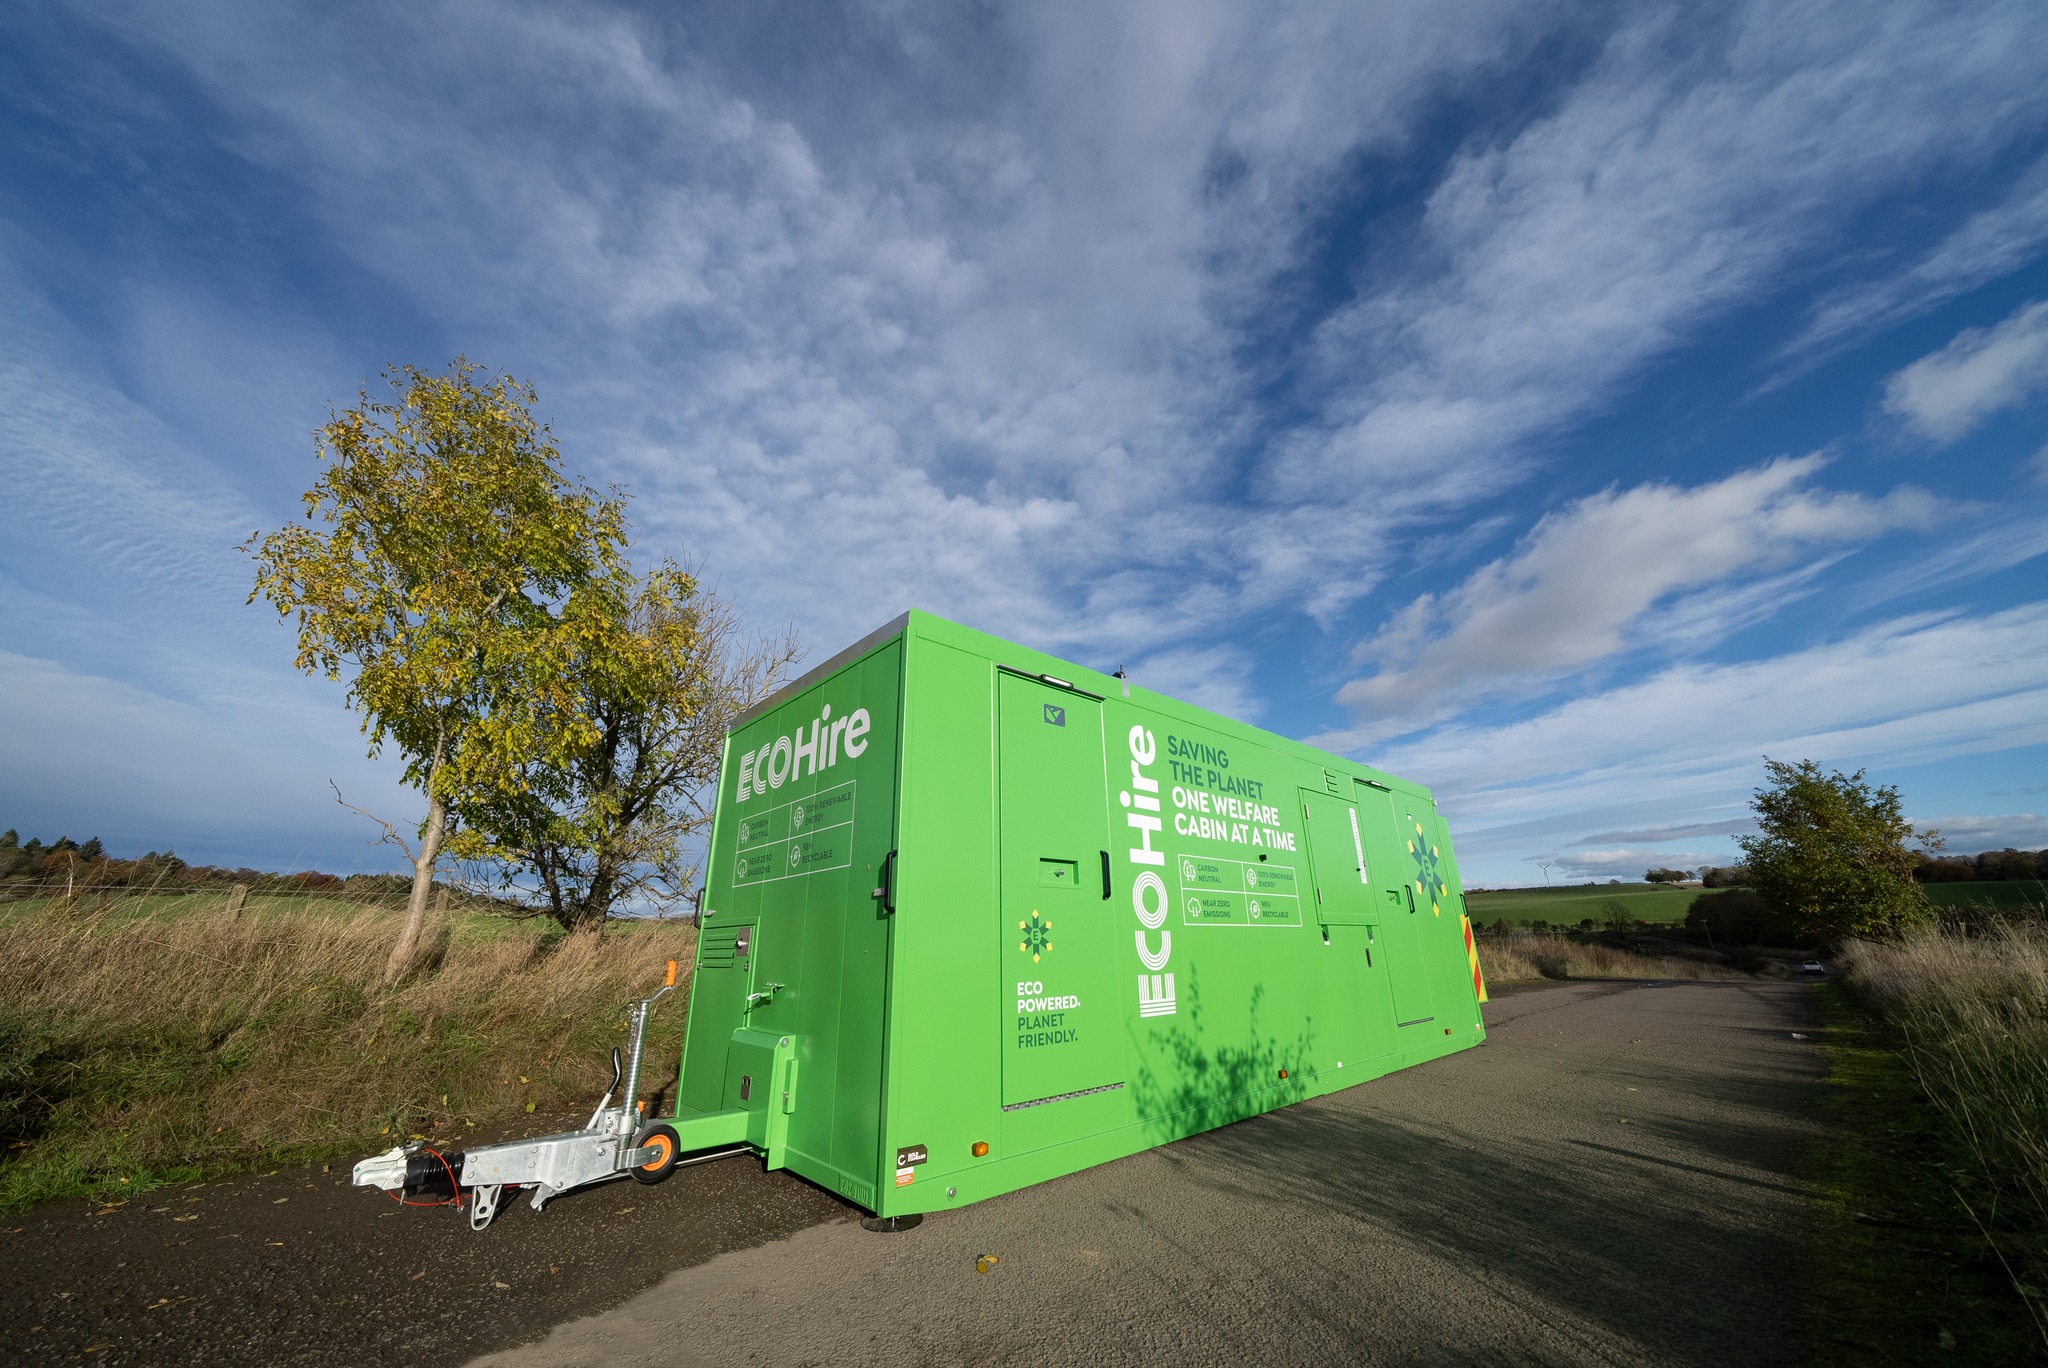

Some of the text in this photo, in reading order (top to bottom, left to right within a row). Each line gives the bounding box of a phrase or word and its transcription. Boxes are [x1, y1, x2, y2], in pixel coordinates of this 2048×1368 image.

[736, 704, 870, 803] ECOHire
[1167, 735, 1229, 769] SAVING
[1169, 760, 1263, 800] THE PLANET
[819, 791, 852, 809] RENEWABLE
[1172, 786, 1280, 826] ONE WELFARE
[751, 820, 769, 831] CARBON
[805, 813, 825, 826] ENERGY
[750, 831, 769, 841] NEUTRAL
[1174, 812, 1296, 851] CABIN AT A TIME
[748, 853, 773, 866] NEAR ZERO
[802, 849, 833, 864] RECYCLABLE
[747, 866, 771, 877] EMISSIONS
[1120, 725, 1177, 1018] ECOHire
[1197, 864, 1219, 873] CARBON
[1423, 860, 1432, 877] E
[1198, 875, 1222, 884] NEUTRAL
[1269, 872, 1294, 881] RENEWABLE
[1202, 900, 1231, 908] NEAR ZERO
[1262, 911, 1289, 919] RECYCLABLE
[1033, 930, 1039, 941] E
[1017, 981, 1043, 996] ECO
[1017, 995, 1081, 1013] POWERED.
[1018, 1013, 1065, 1031] PLANET
[1018, 1028, 1078, 1049] FRIENDLY.
